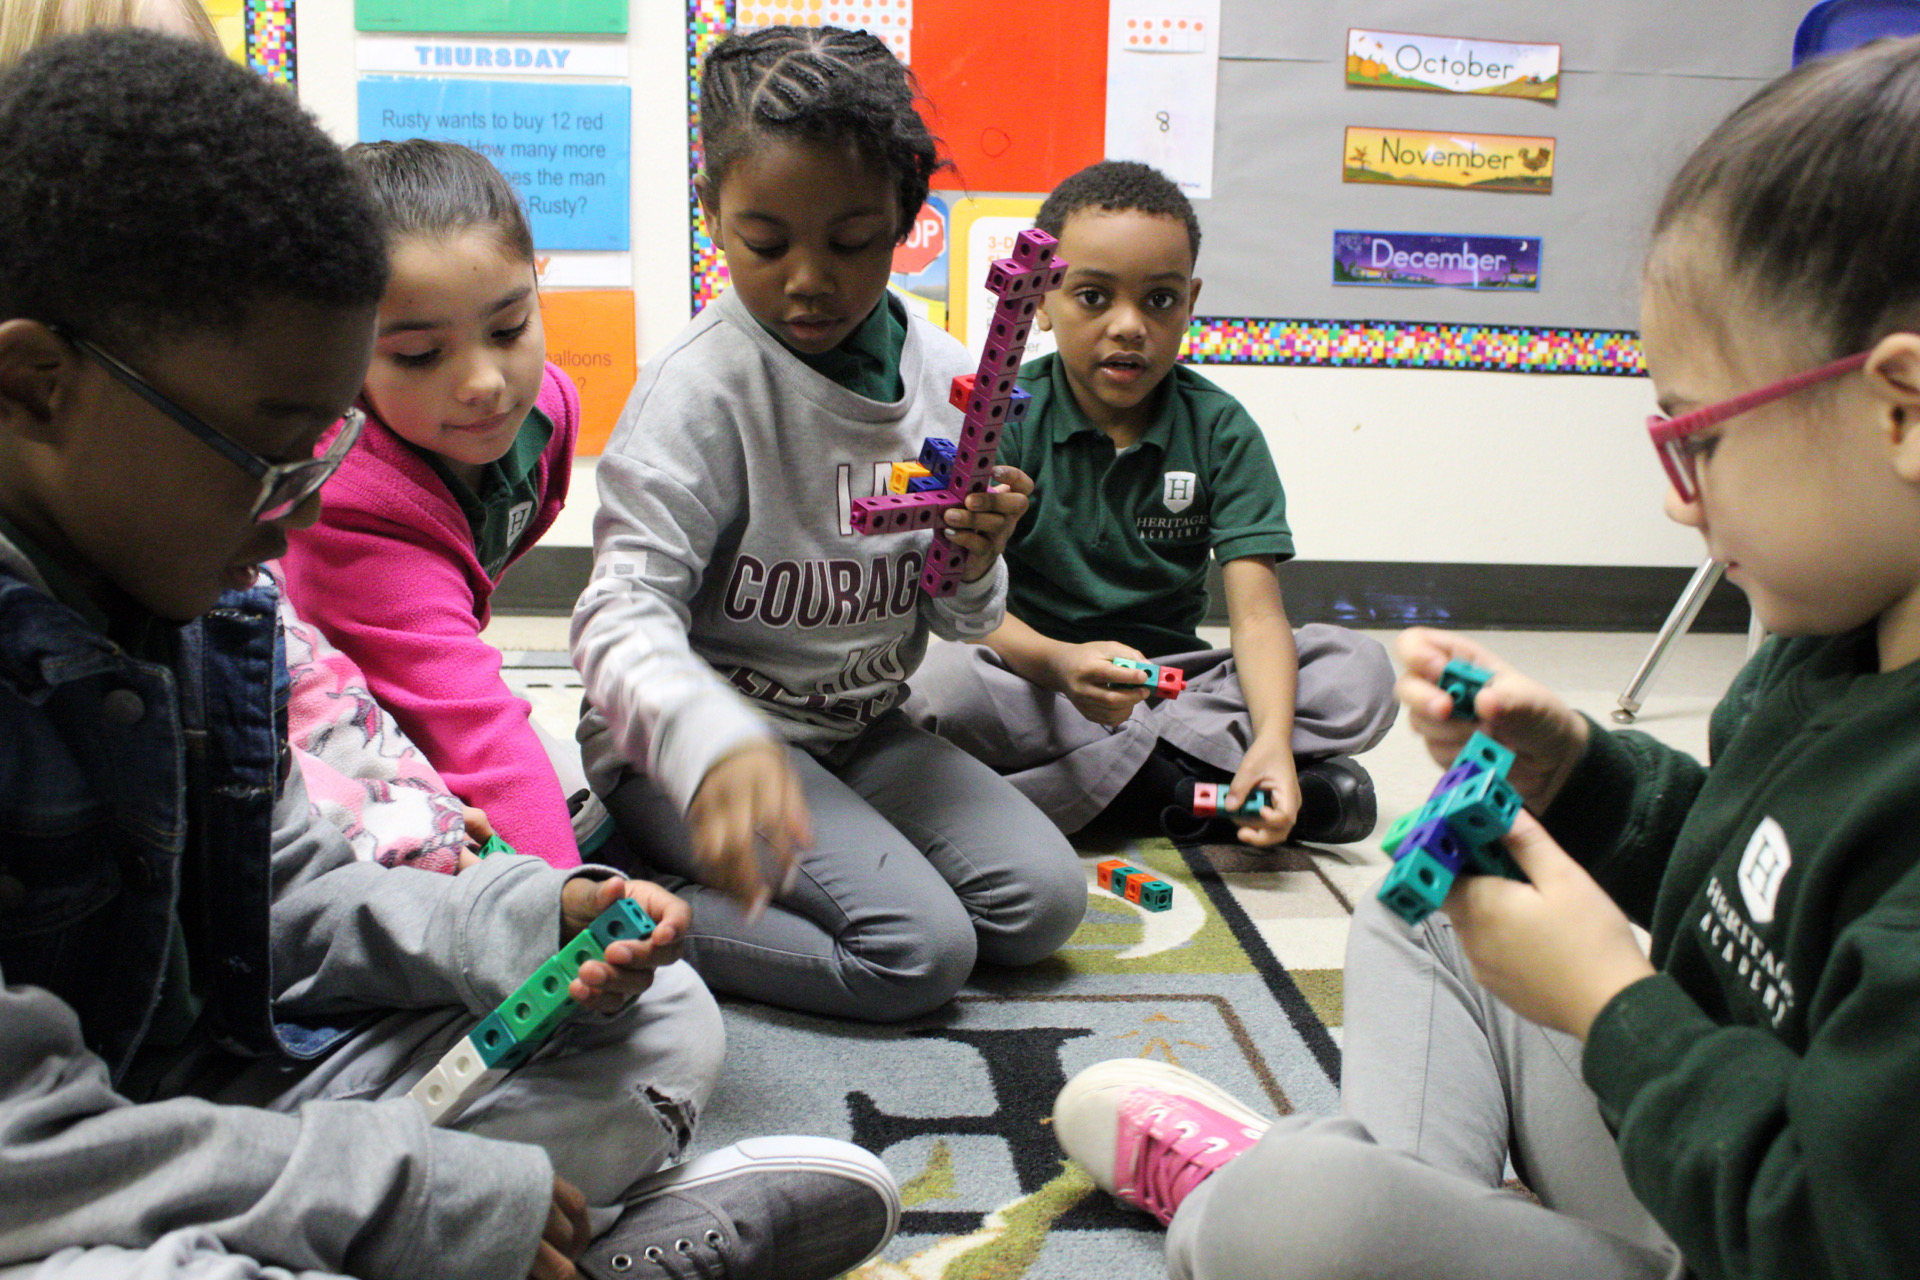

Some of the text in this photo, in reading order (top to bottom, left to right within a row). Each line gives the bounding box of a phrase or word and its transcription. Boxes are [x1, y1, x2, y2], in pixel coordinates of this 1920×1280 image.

[414, 45, 571, 69] THURSDAY
[1395, 44, 1515, 80] October
[382, 109, 603, 134] Rusty wants to buy 12 red
[1156, 111, 1170, 133] 8
[511, 143, 557, 161] many
[563, 144, 606, 159] more
[1380, 136, 1515, 170] November
[502, 167, 605, 187] oes the man
[528, 195, 587, 218] Rusty?
[906, 219, 939, 248] OP
[987, 235, 1014, 250] 3-D
[1371, 238, 1507, 271] December
[1167, 478, 1191, 500] H
[508, 507, 529, 537] H
[1136, 514, 1208, 529] HERITAGE
[723, 550, 923, 630] COURAG
[1747, 834, 1780, 904] H
